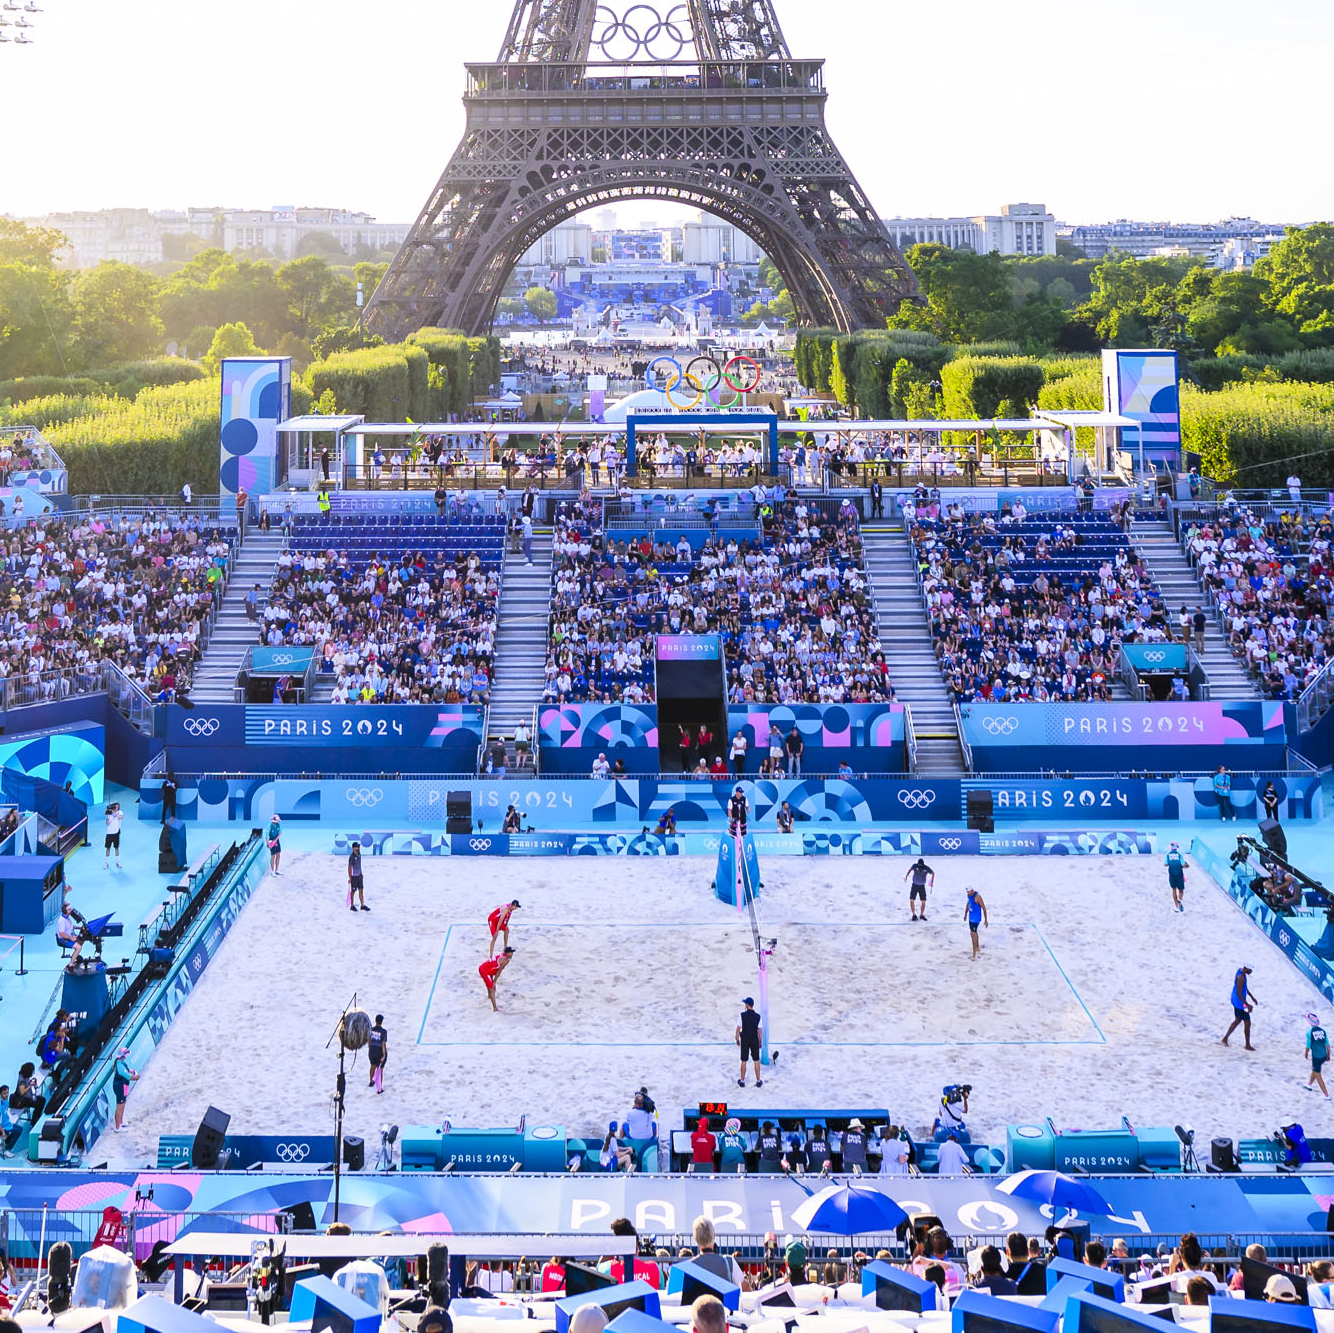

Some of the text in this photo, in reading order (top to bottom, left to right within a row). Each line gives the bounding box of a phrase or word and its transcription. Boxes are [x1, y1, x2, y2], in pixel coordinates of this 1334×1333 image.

[661, 644, 715, 652] PARIS 2024
[264, 719, 403, 735] PARIS 2024
[1064, 716, 1204, 733] PARIS 2024
[429, 790, 573, 808] PIS 2024
[998, 789, 1128, 807] ARIS 2024
[165, 1146, 189, 1157] PAR
[451, 1154, 515, 1162] PARIS 2024
[1248, 1151, 1325, 1161] PARIS 24
[1064, 1156, 1130, 1165] PARIS 2024
[571, 1199, 784, 1231] PARI
